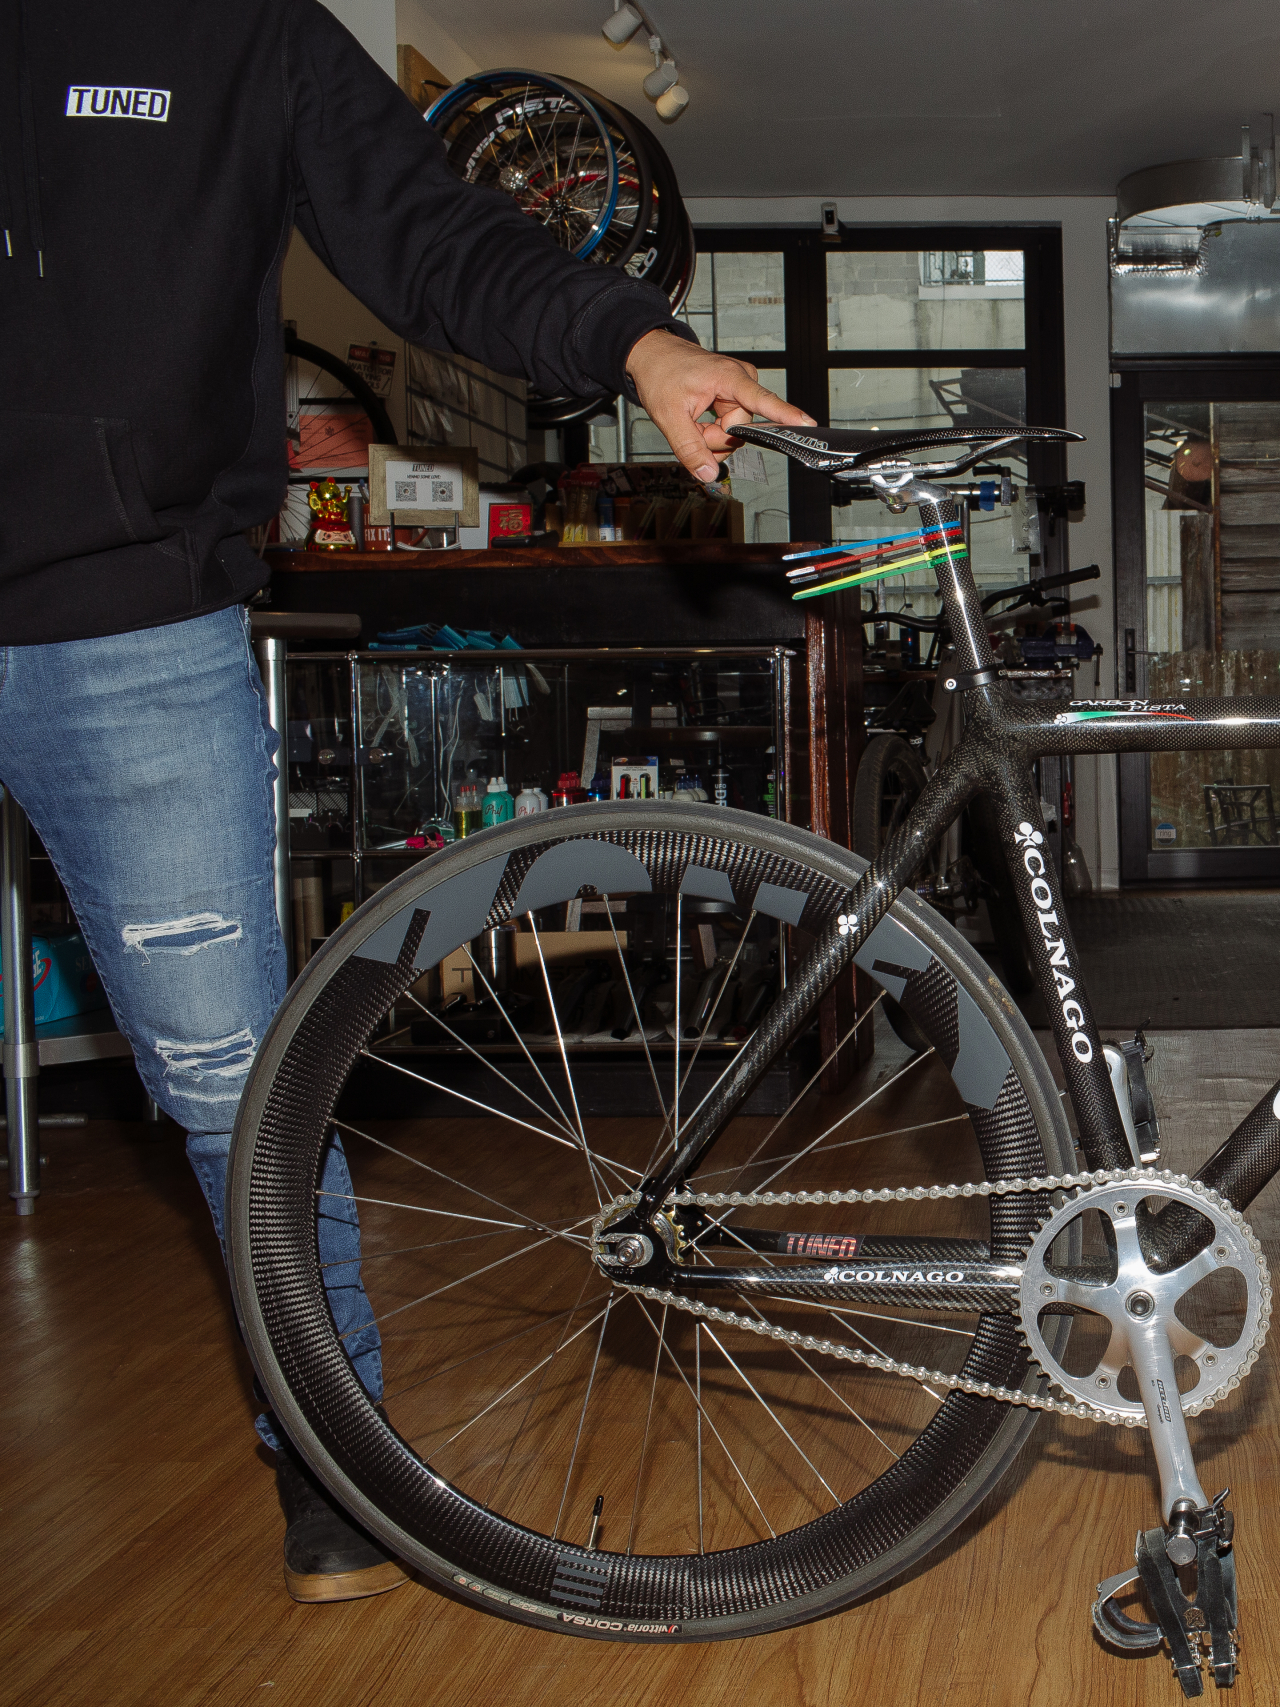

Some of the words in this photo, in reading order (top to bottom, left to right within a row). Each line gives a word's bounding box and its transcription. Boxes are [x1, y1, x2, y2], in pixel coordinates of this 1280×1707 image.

[72, 88, 168, 119] TUNED
[412, 463, 435, 472] TUNED
[498, 508, 524, 531] 福
[364, 528, 376, 541] FIX
[1128, 704, 1187, 712] PISTA
[484, 803, 503, 816] Phil
[517, 805, 535, 817] Phil
[1024, 847, 1093, 1064] COLNAGO
[838, 1270, 965, 1283] COLNAGO
[562, 1612, 622, 1631] CORSA
[626, 1623, 669, 1633] vittoria
